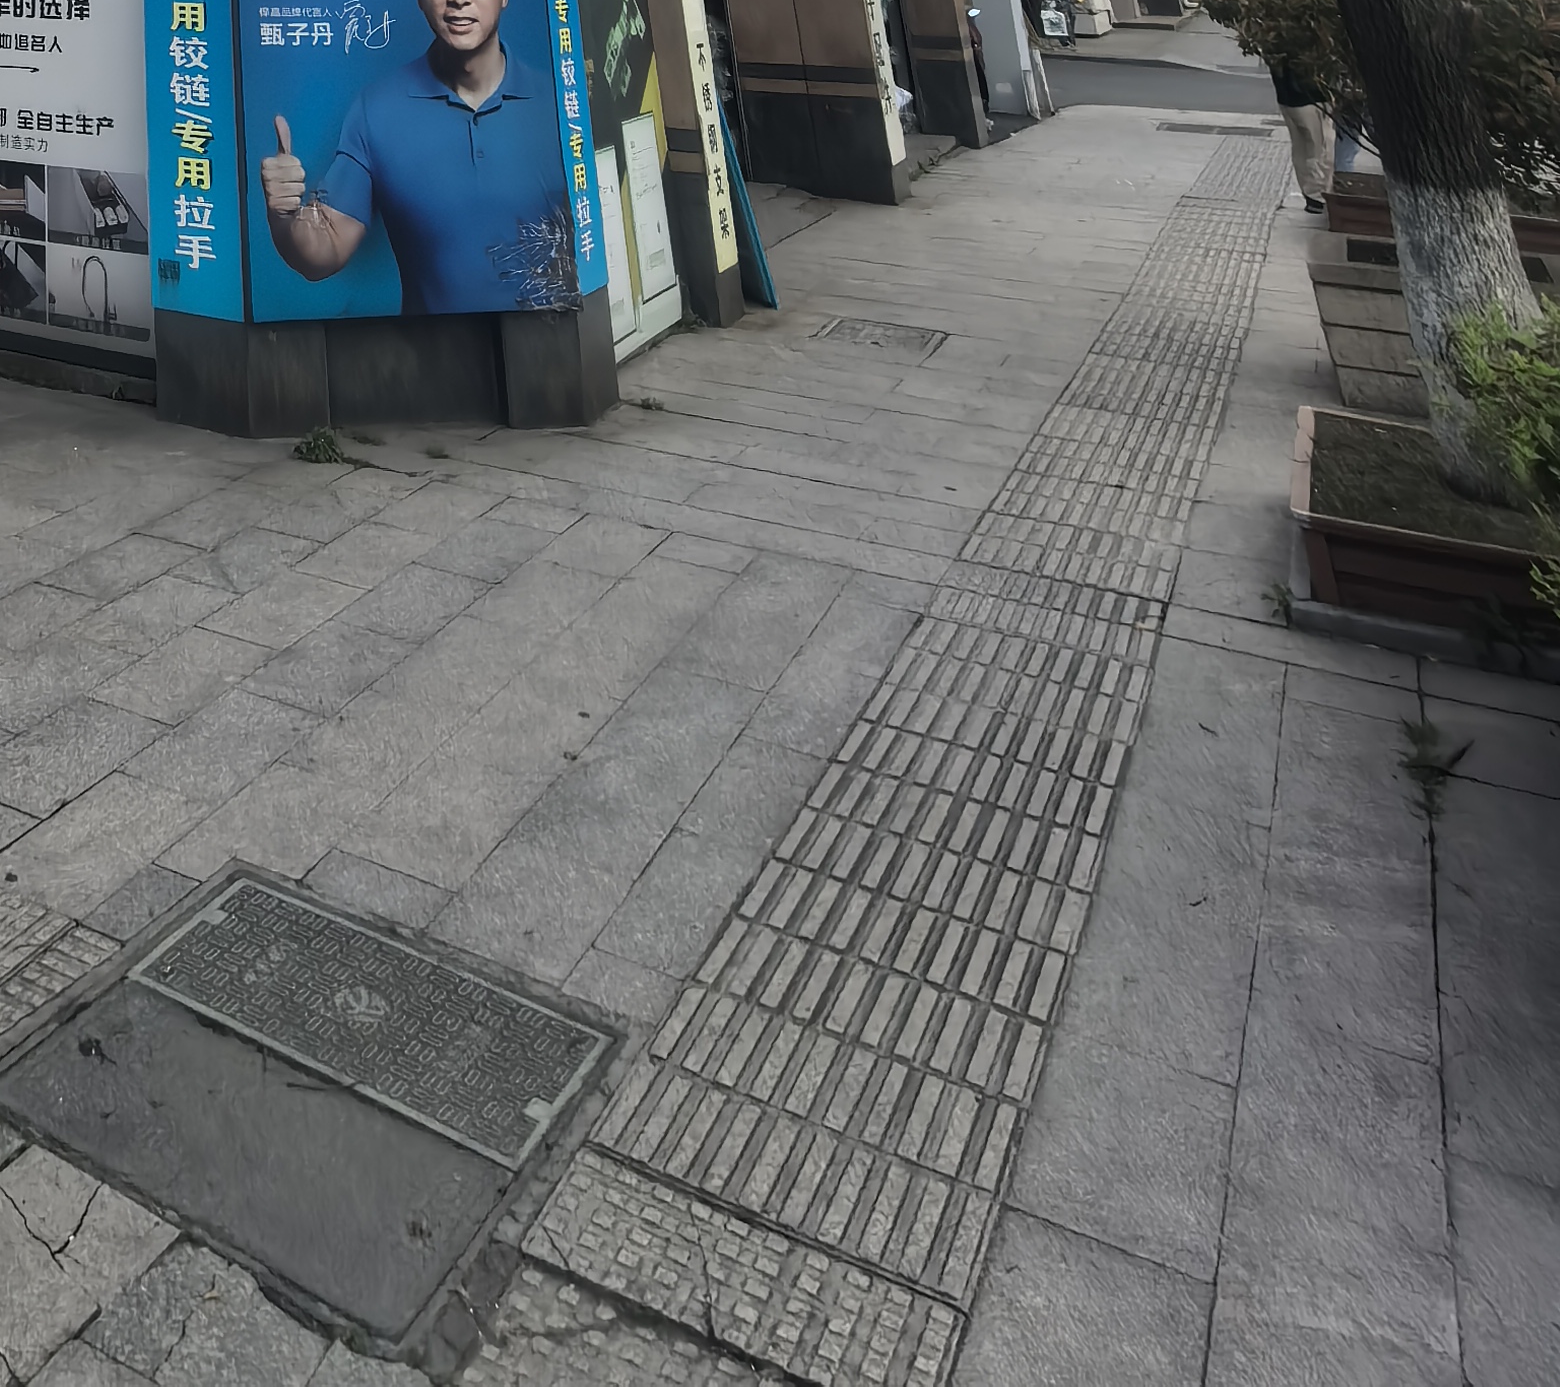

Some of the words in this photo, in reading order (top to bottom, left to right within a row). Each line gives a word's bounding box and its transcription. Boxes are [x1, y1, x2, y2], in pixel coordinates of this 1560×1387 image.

[259, 22, 335, 47] 甄子丹
[17, 108, 116, 137] 全自主生产
